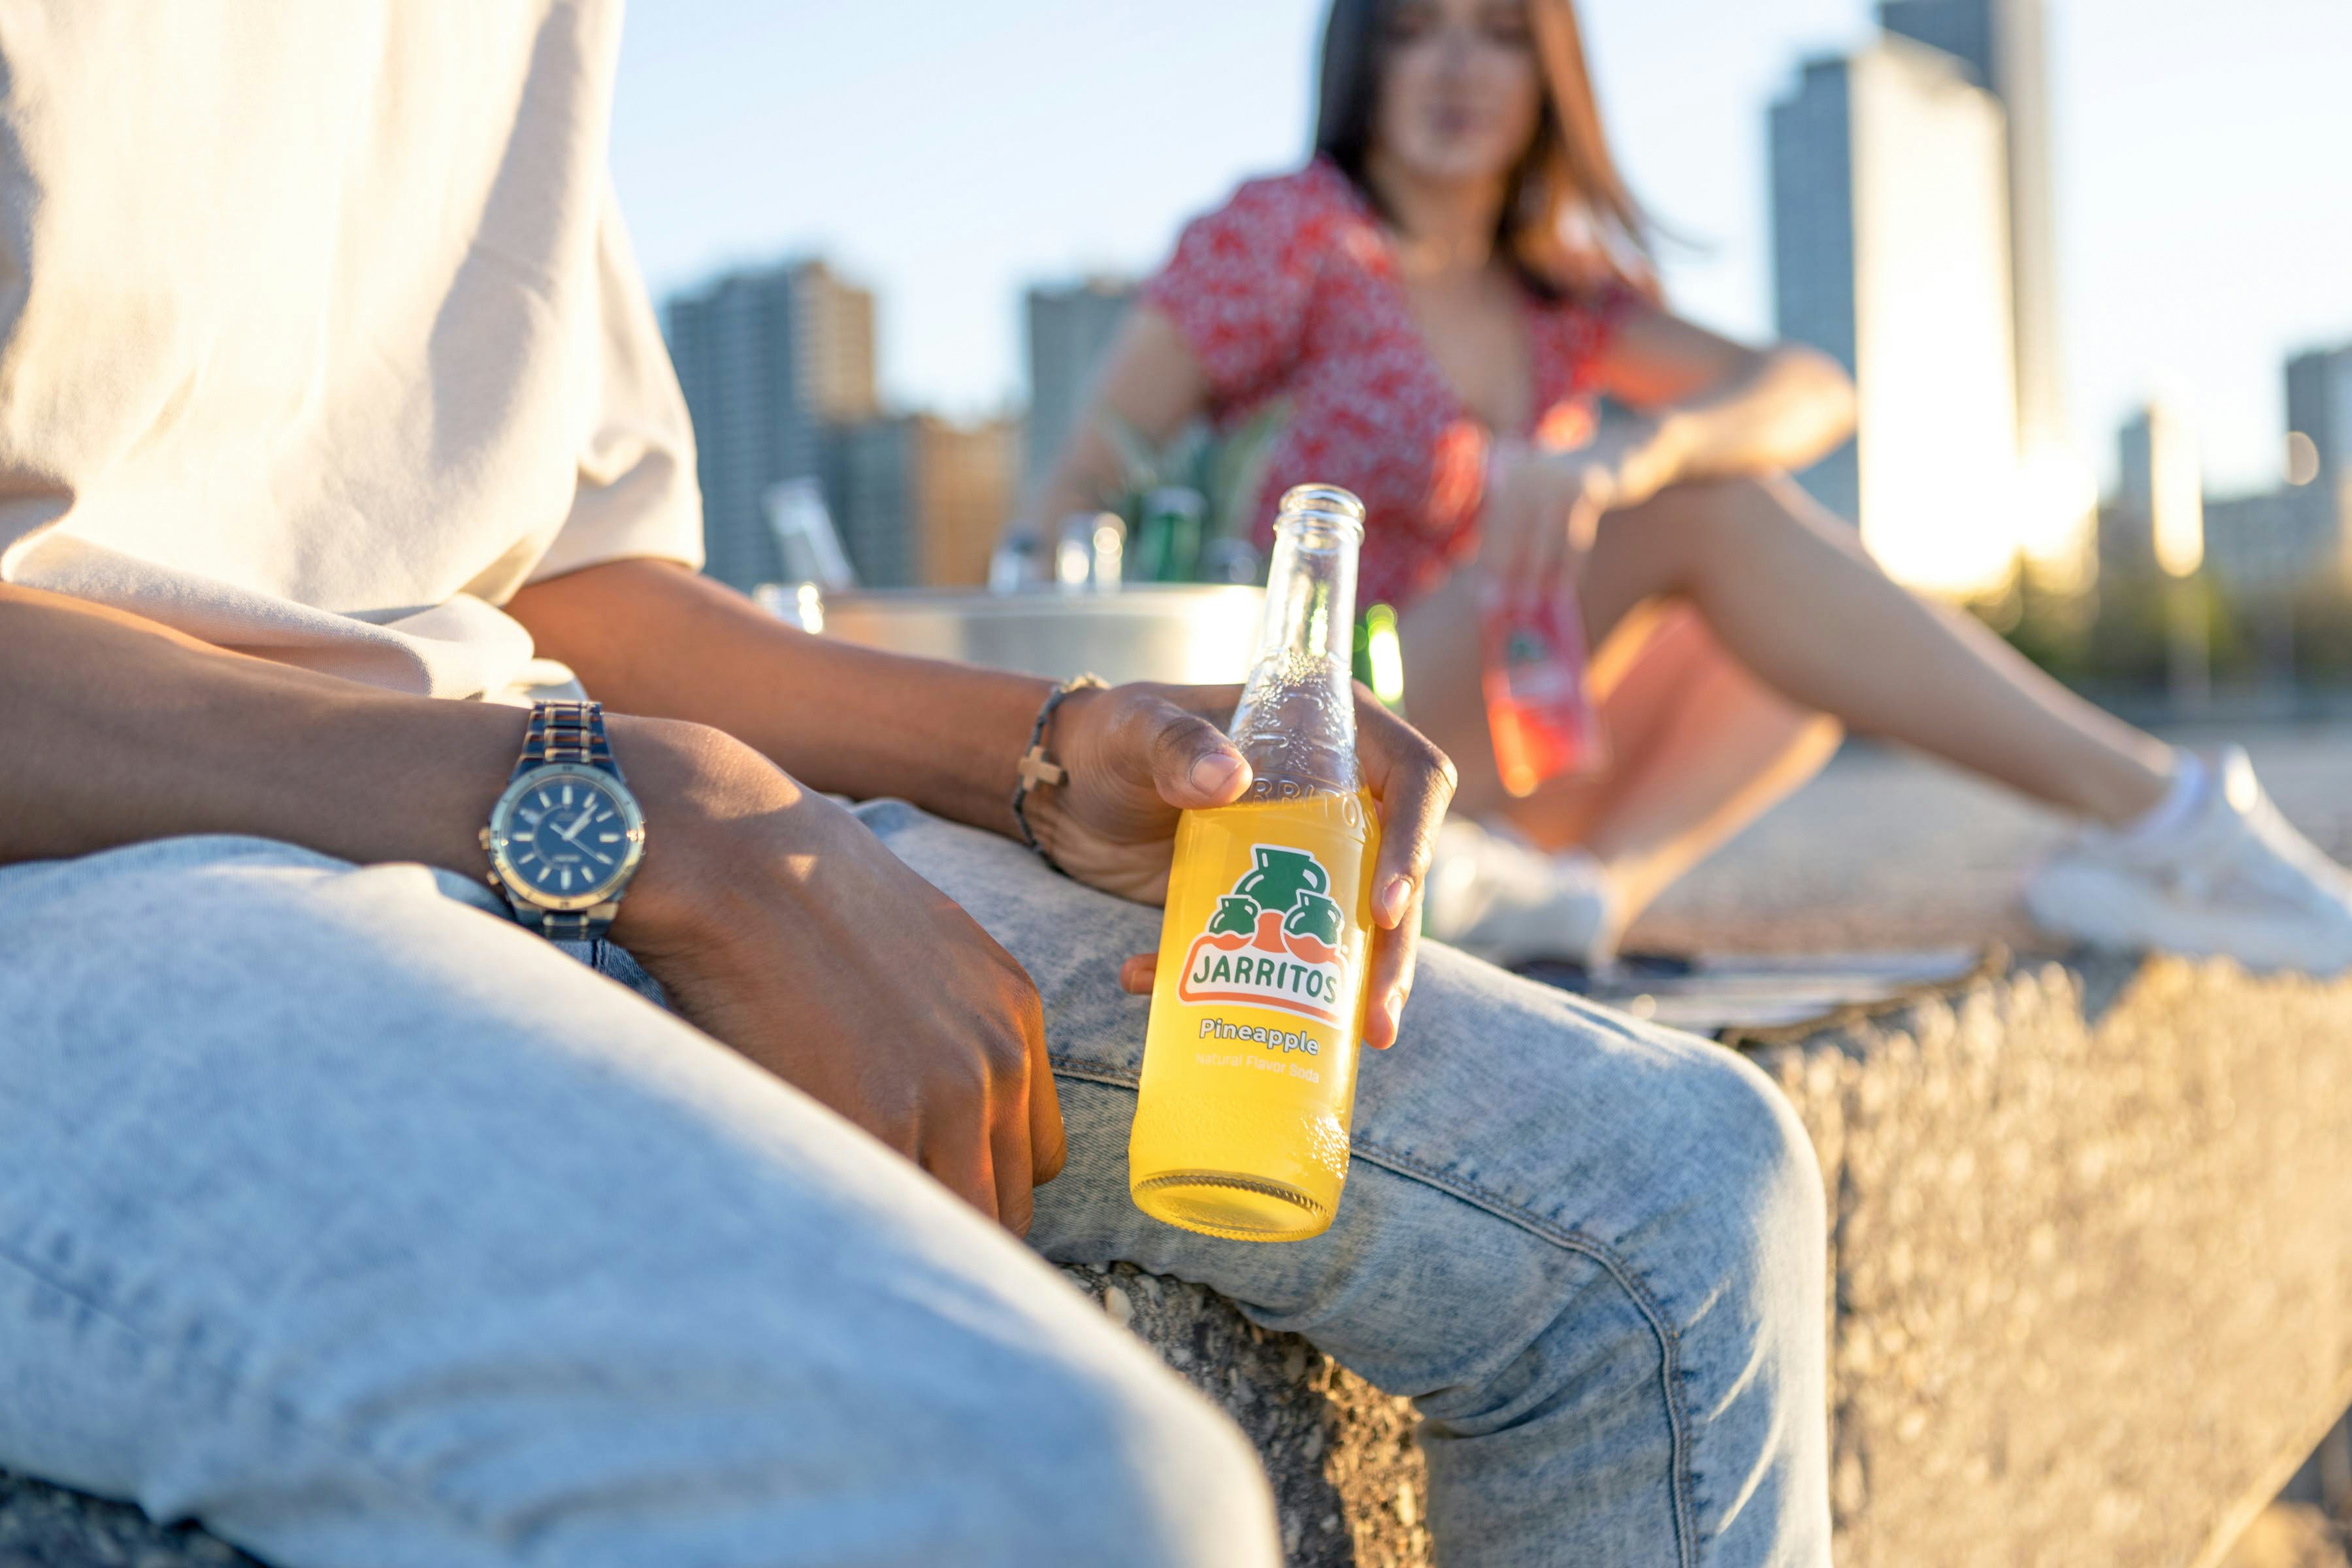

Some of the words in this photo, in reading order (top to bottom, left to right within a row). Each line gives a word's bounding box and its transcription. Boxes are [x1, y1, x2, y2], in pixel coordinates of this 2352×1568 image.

[1193, 955, 1337, 1004] JARRITOS
[1199, 1018, 1320, 1056] Pineapple
[1196, 1053, 1243, 1067] Natural
[1246, 1055, 1286, 1074] Flavor
[1289, 1063, 1320, 1084] Soda
